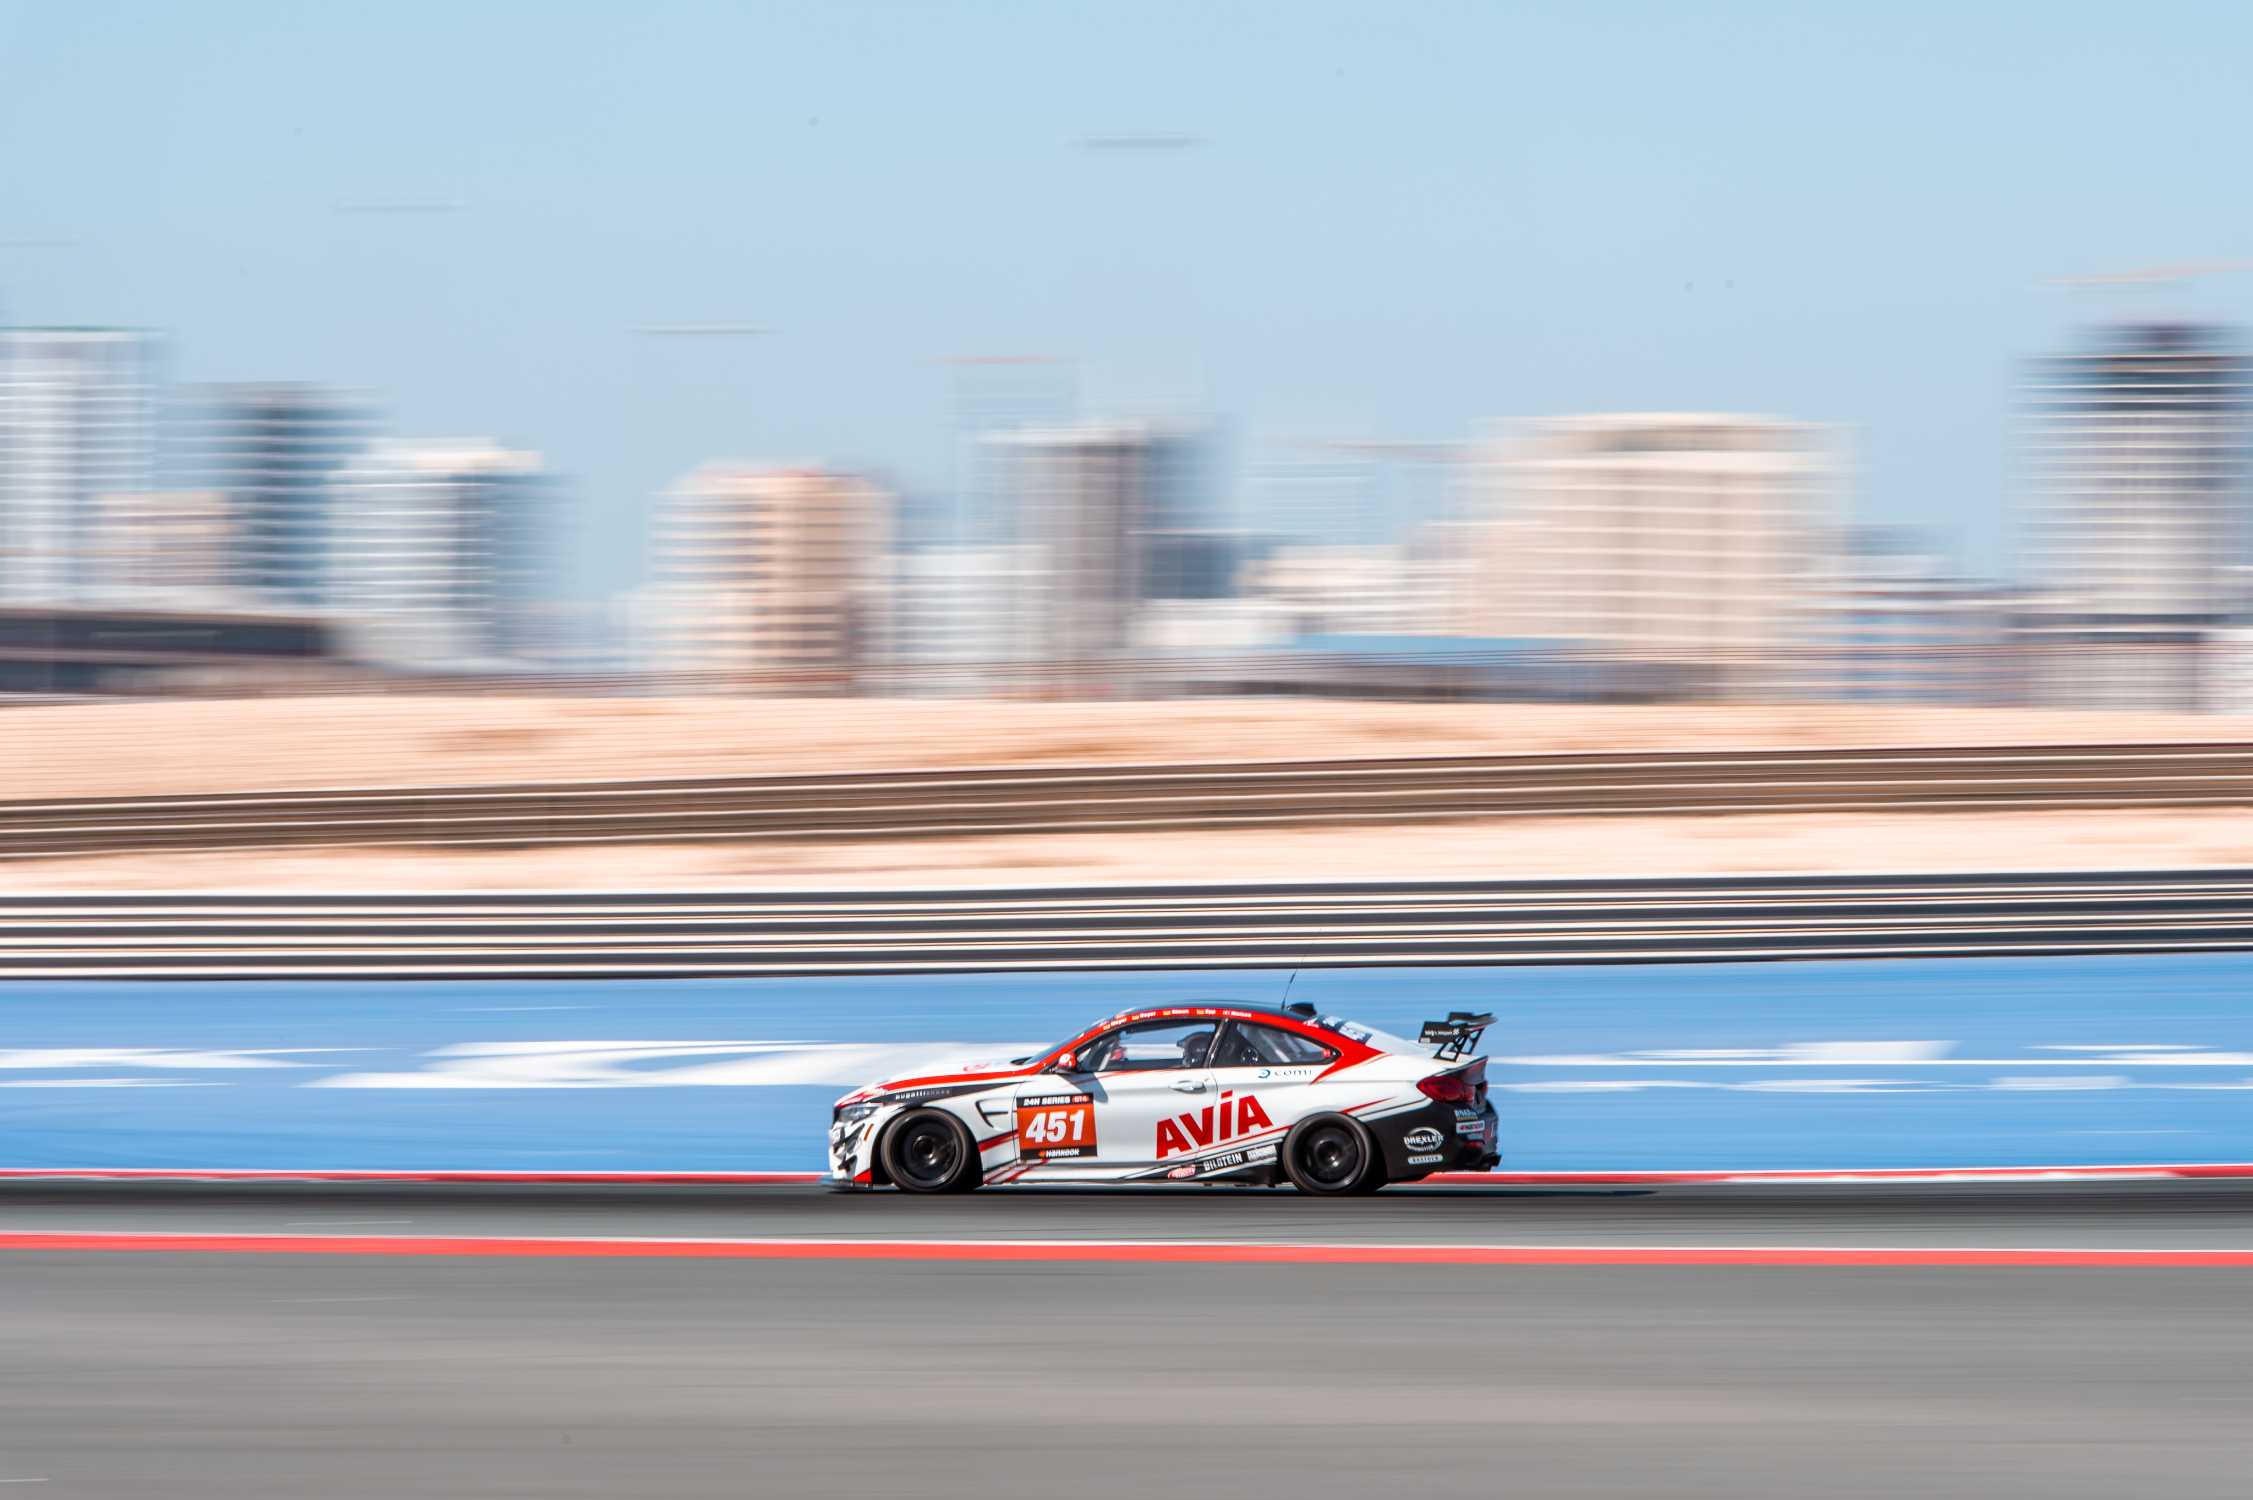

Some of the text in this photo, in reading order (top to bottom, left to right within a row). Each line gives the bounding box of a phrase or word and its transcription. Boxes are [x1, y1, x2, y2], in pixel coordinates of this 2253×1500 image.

[1023, 1097, 1041, 1106] 24H
[1042, 1096, 1071, 1105] SERIES
[1025, 1109, 1085, 1143] 451
[1403, 1134, 1444, 1145] DREXLER
[1203, 1153, 1242, 1171] BILSTEIN
